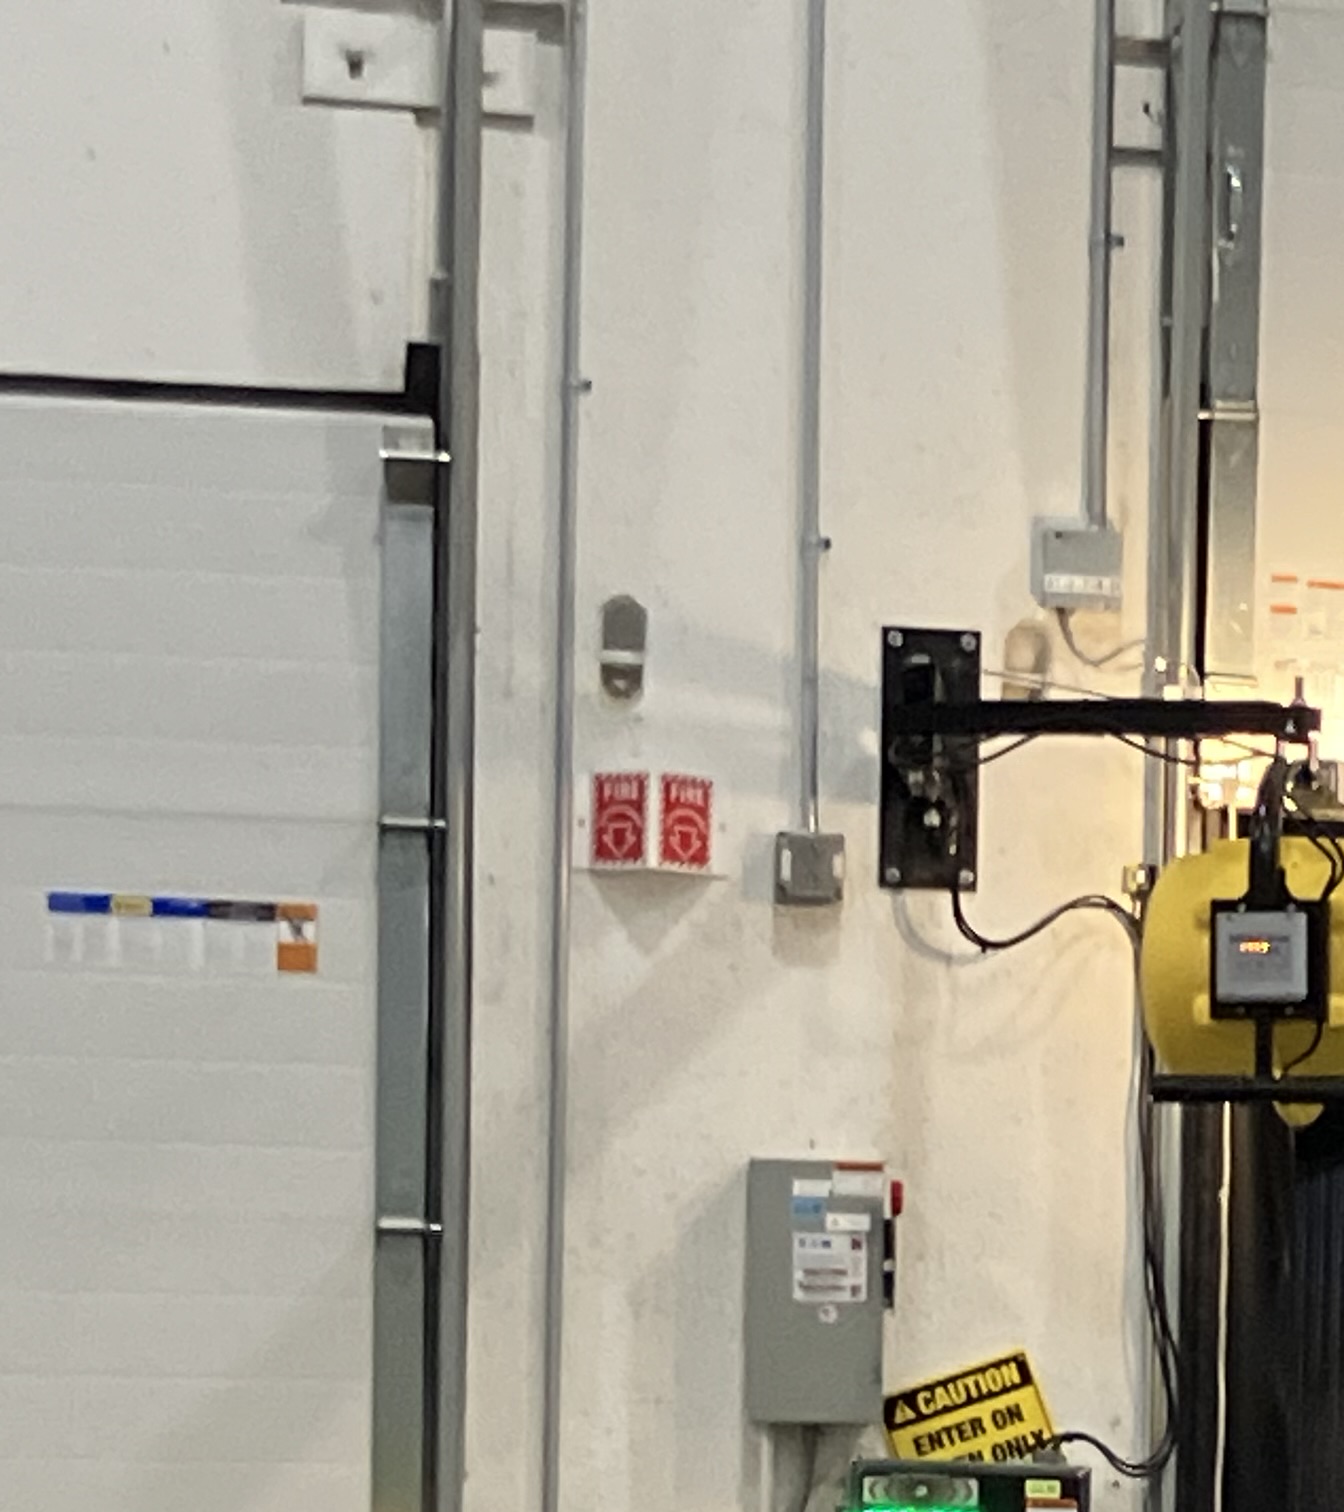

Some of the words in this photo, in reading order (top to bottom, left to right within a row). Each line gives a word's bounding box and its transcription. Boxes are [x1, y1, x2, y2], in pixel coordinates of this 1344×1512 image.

[916, 1360, 1022, 1417] CAUTION
[912, 1417, 987, 1458] ENTER
[991, 1402, 1026, 1431] ON
